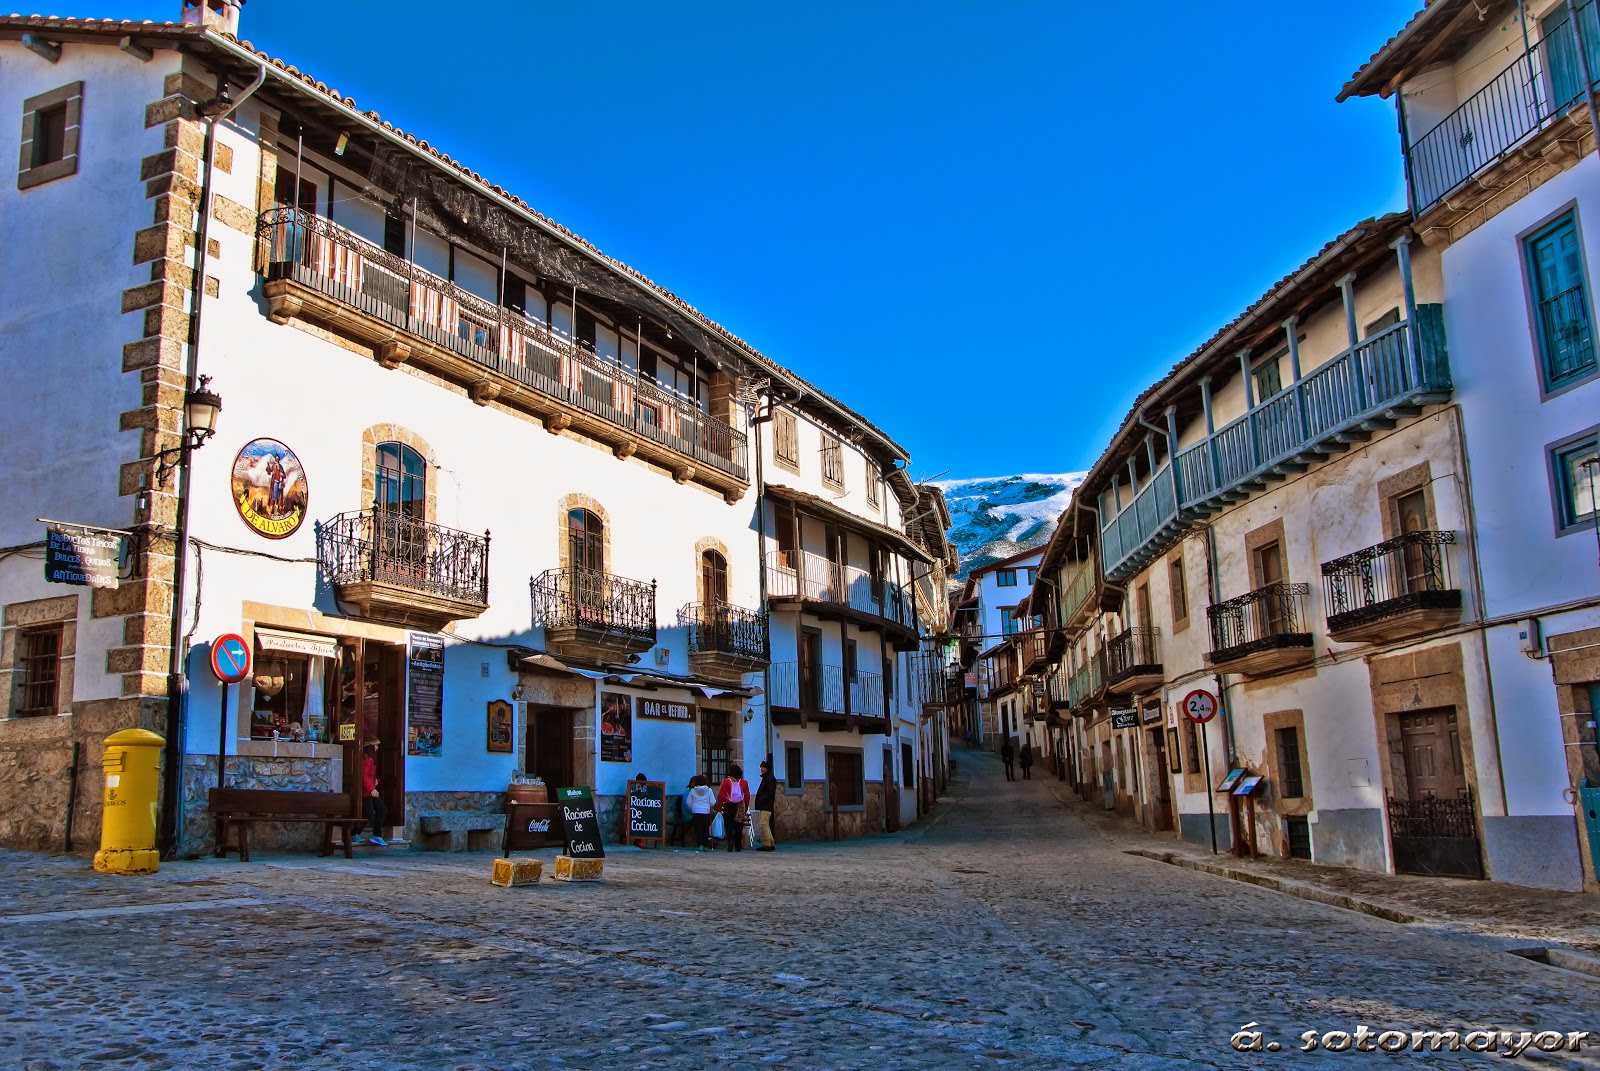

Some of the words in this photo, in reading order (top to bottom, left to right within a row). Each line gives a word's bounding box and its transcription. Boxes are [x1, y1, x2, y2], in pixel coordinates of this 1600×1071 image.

[243, 508, 261, 526] DE
[259, 515, 297, 534] ALVARO
[50, 531, 91, 547] PRODUCTOS
[50, 541, 61, 550] DE
[62, 542, 72, 552] LA
[73, 544, 96, 556] TIERRA
[644, 701, 661, 717] BAR
[661, 704, 668, 714] EL
[630, 795, 662, 808] Raciones
[563, 805, 594, 821] Raciones
[630, 807, 643, 819] De
[574, 820, 584, 832] de
[631, 819, 659, 832] Cocina
[570, 839, 596, 854] Cocina
